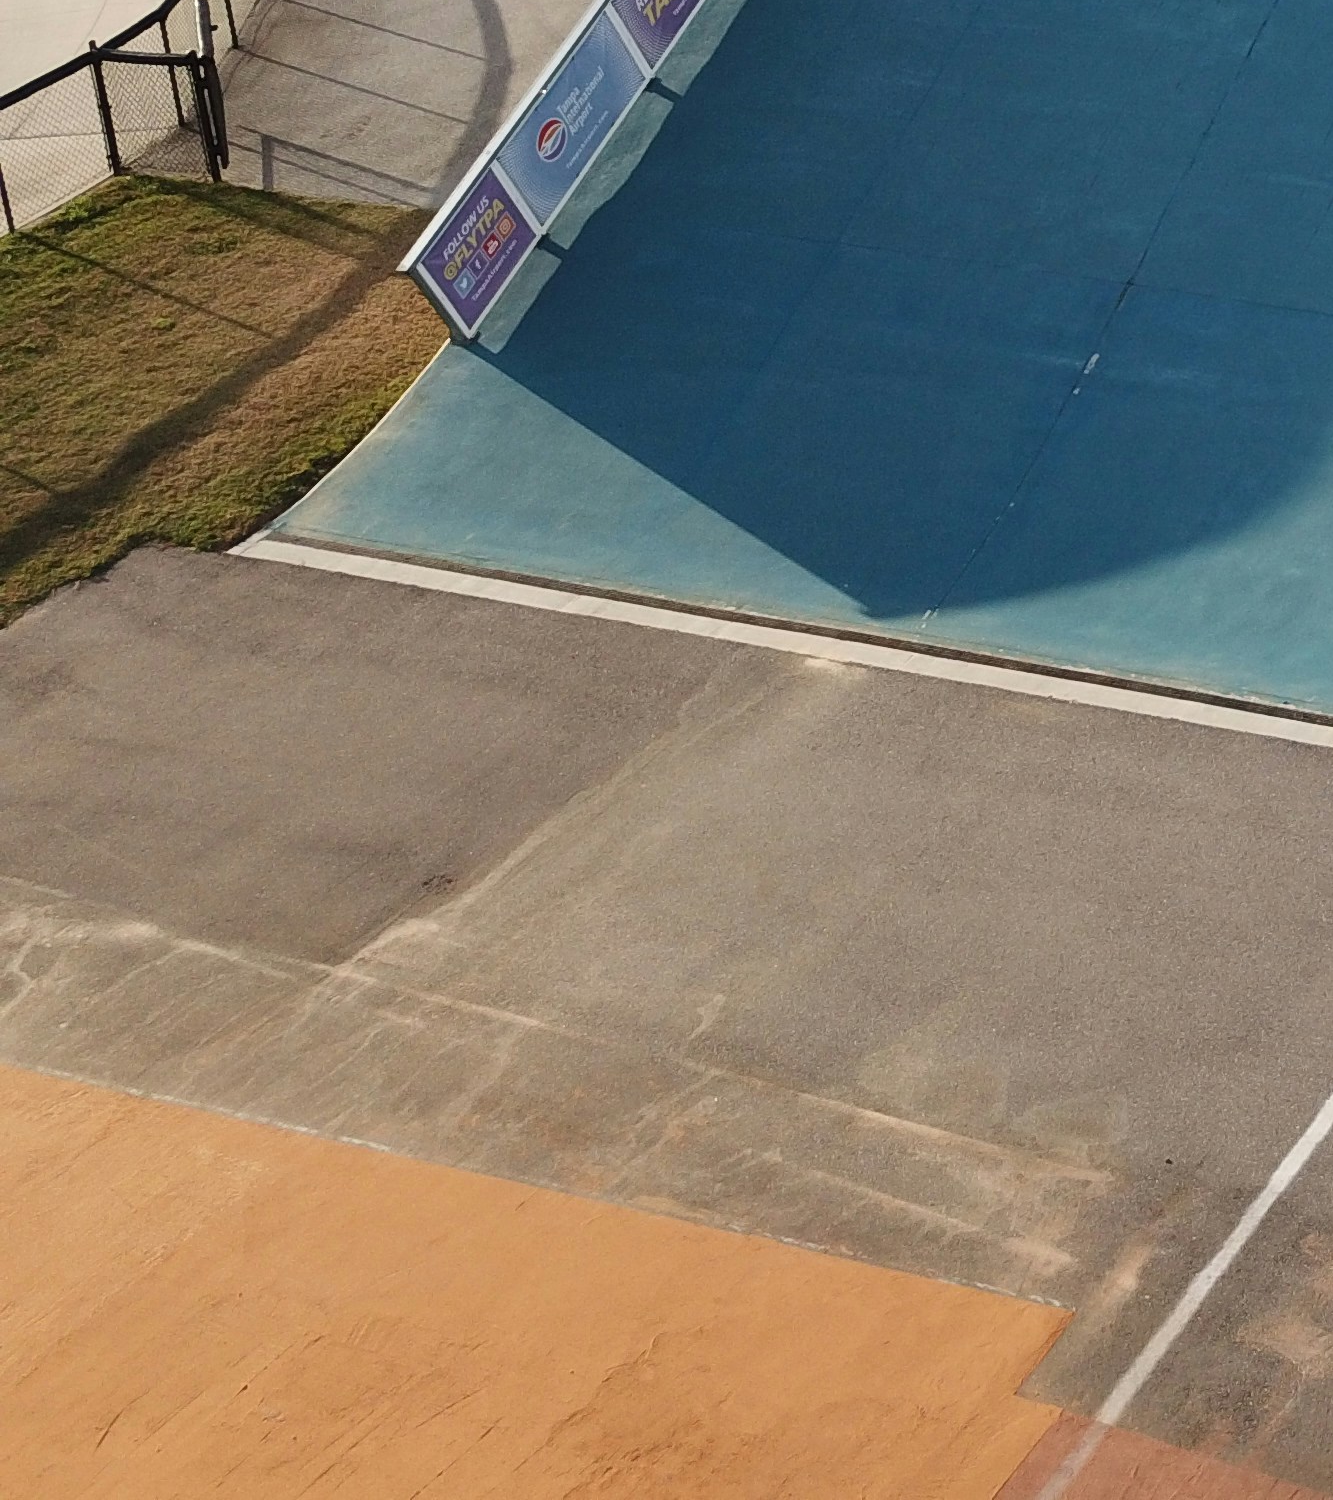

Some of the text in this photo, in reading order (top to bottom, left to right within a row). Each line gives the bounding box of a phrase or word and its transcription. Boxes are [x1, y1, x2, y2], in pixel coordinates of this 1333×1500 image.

[556, 87, 581, 114] Tampa
[567, 102, 594, 137] Airport
[442, 195, 490, 261] FOLLOW US
[443, 198, 505, 280] @FLYTPA
